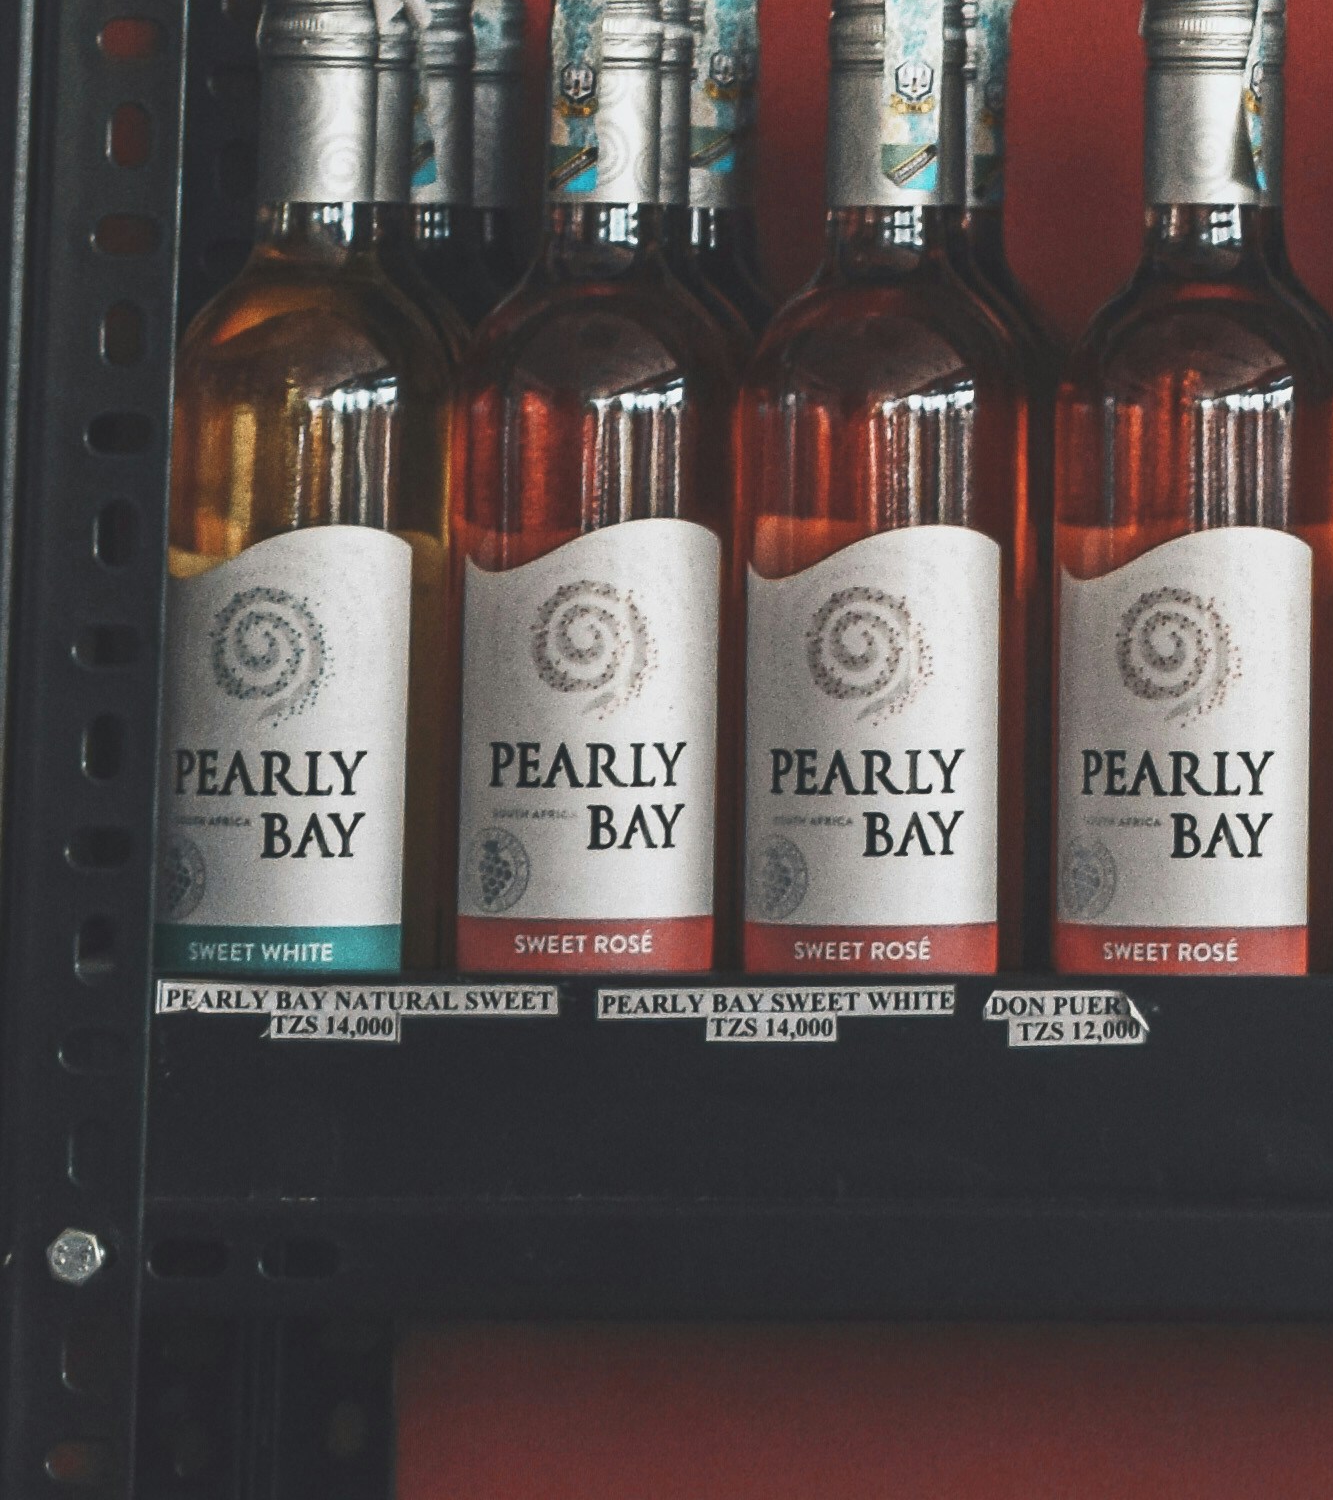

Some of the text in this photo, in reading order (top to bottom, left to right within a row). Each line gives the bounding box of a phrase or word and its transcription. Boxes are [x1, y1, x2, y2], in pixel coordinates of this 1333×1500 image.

[174, 749, 367, 797] PEARLY
[489, 742, 687, 788] PEARLY
[769, 748, 966, 795] PEARLY
[1081, 749, 1276, 796] PEARLY
[260, 812, 366, 859] BAY
[586, 804, 686, 850] BAY
[863, 811, 965, 857] BAY
[1170, 812, 1274, 859] BAY
[188, 942, 334, 963] SWEET WHITE
[514, 928, 653, 954] SWEET ROSÉ
[794, 935, 931, 961] SWEET ROSÉ
[1103, 937, 1239, 962] SWEET ROSÉ
[166, 988, 553, 1010] PEARLY BAY NATURAL SWEET
[602, 990, 955, 1014] PEARLY BAY SWEET WHITE
[991, 996, 1045, 1016] DON
[272, 1015, 394, 1038] TZS 14,000
[711, 1017, 834, 1041] TZS 14,000
[1017, 1020, 1141, 1042] TZS 12,000
